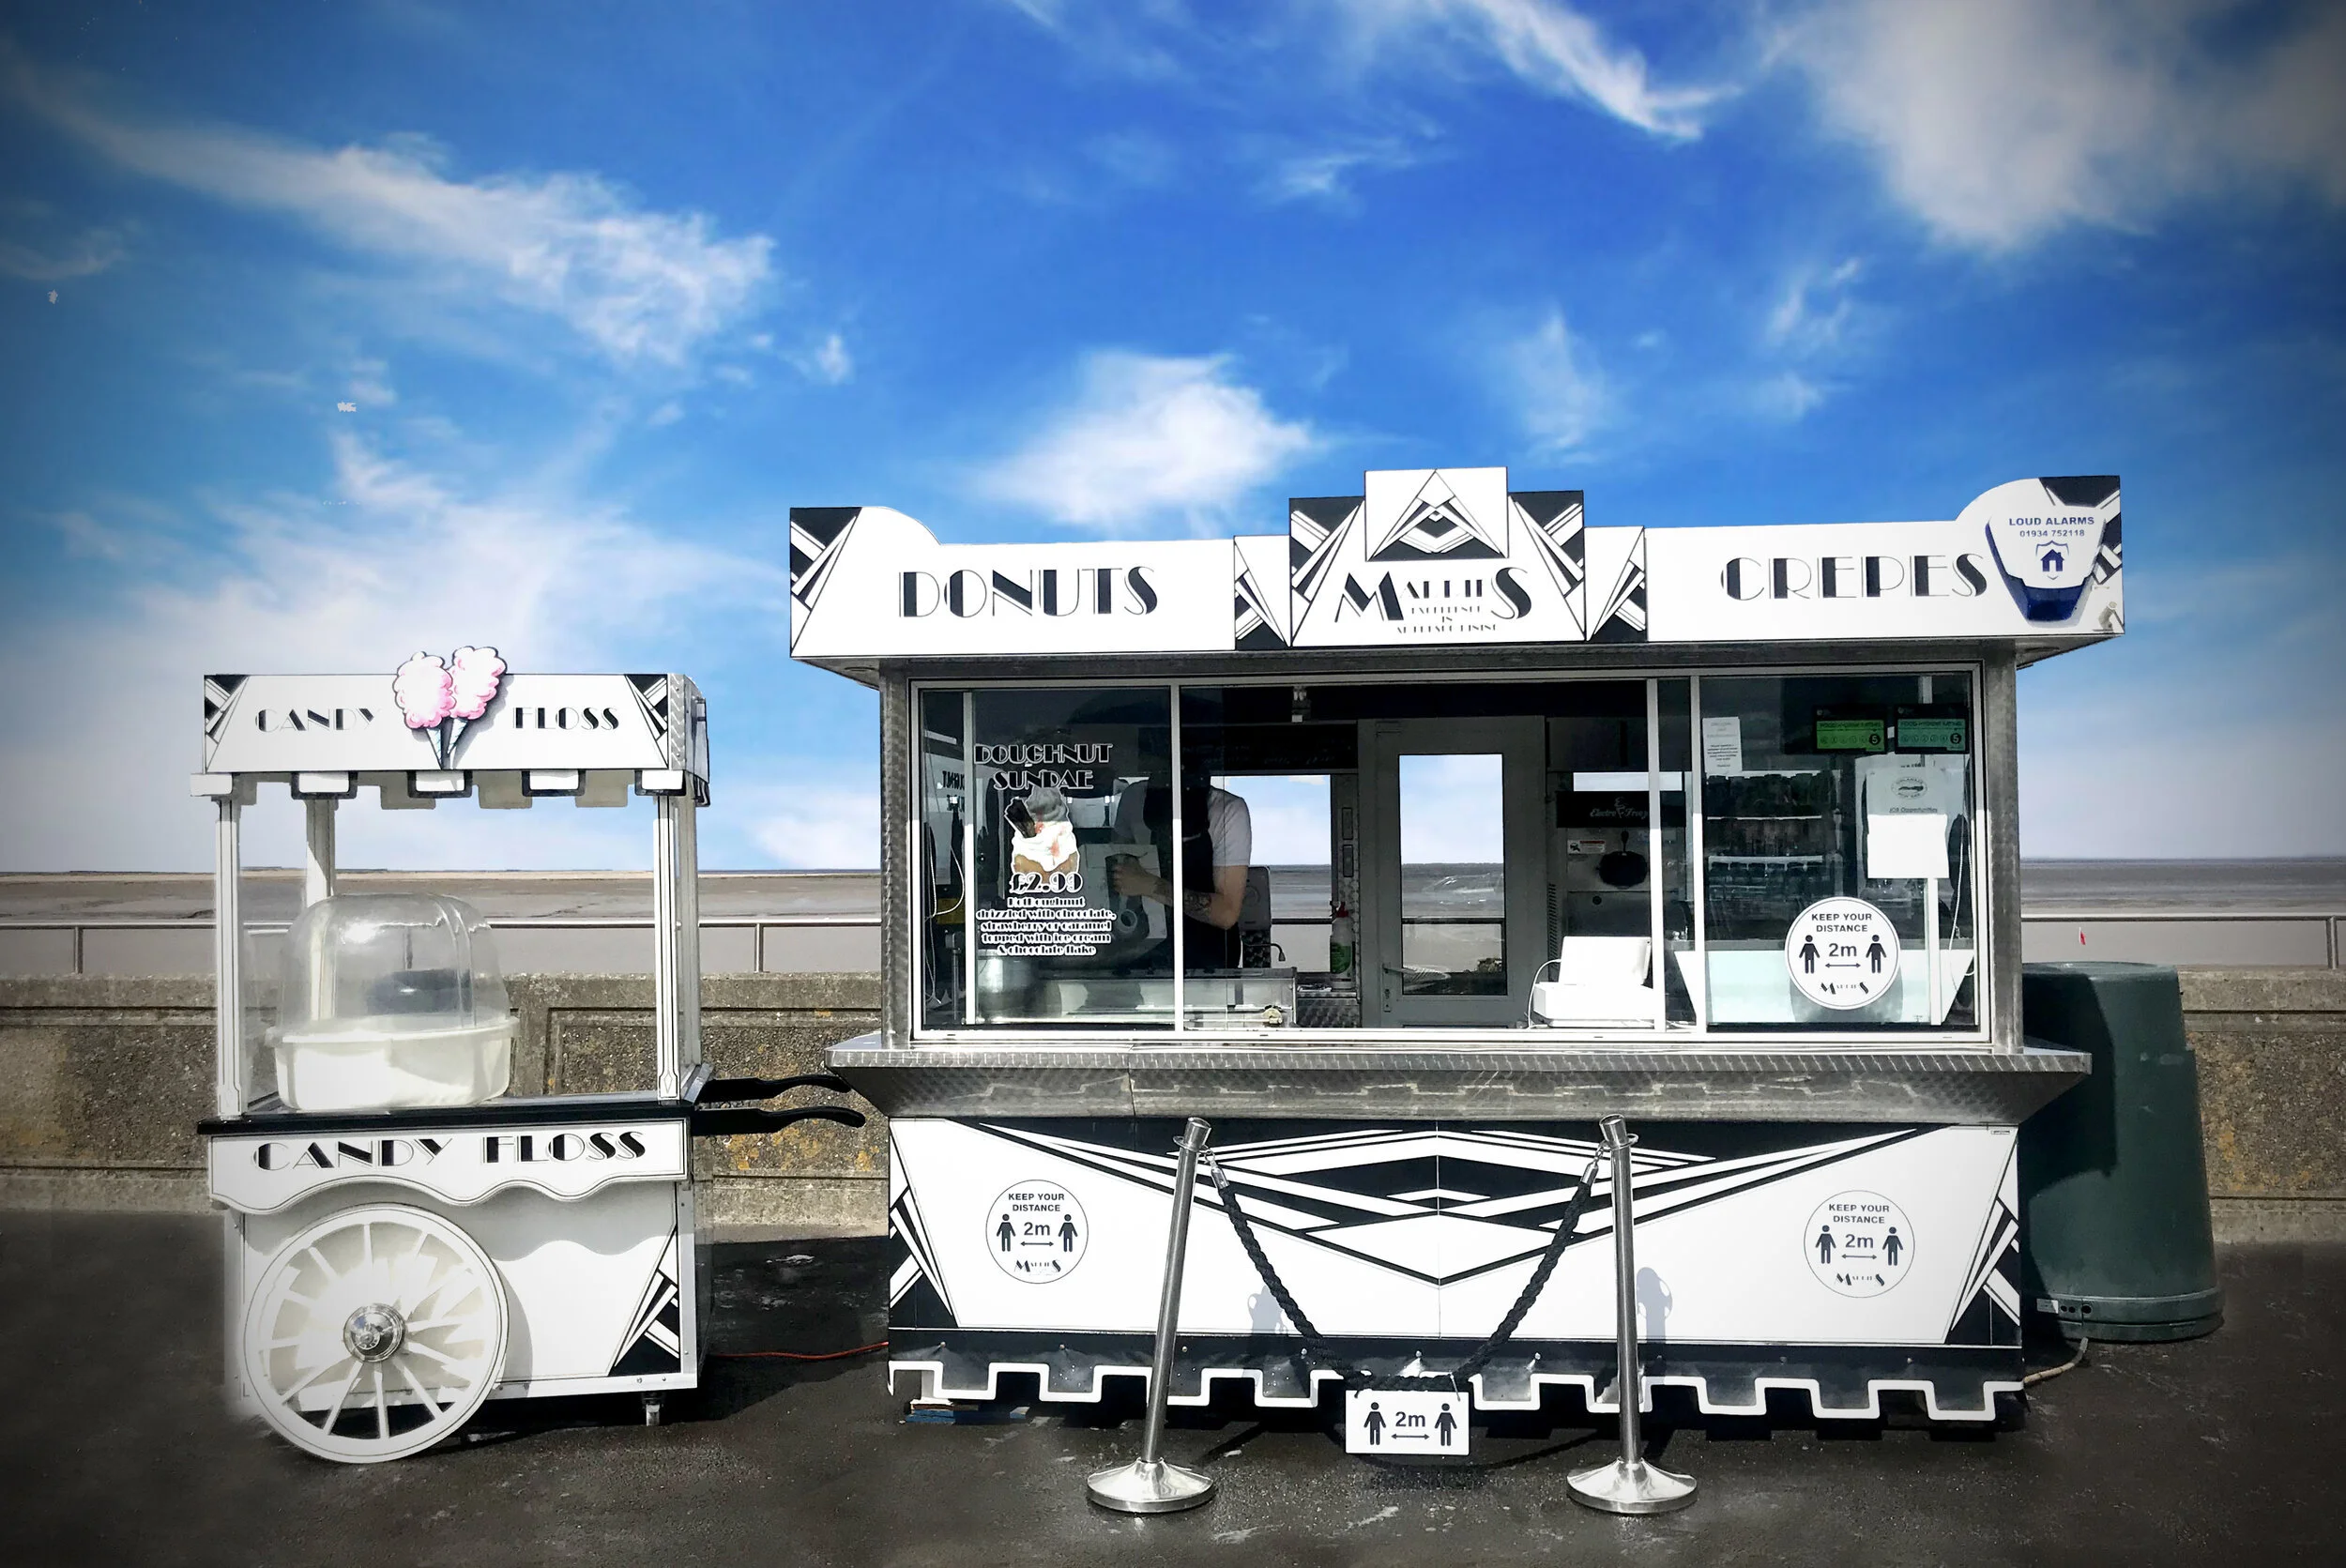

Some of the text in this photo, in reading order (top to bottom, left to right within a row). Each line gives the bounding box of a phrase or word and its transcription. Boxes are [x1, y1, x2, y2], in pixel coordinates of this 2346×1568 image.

[2008, 516, 2095, 526] LOUD ALARMS
[2019, 529, 2049, 538] 01934
[1719, 552, 1988, 601] CREPES
[898, 566, 1158, 618] DONUTS
[254, 706, 620, 734] CANDY FLOSS
[1870, 735, 1879, 744] 5
[1952, 734, 1960, 743] 5
[973, 743, 1114, 765] DOUGHNUT
[993, 769, 1094, 790] SUNDAE
[1008, 871, 1084, 894] £2.99
[1028, 908, 1055, 921] with
[1811, 913, 1873, 921] KEEP YOUR
[1816, 924, 1868, 933] DISTANCE
[1024, 933, 1053, 944] with
[1052, 933, 1072, 944] ice
[1007, 945, 1064, 956] chocolate
[1064, 944, 1097, 956] flake
[1828, 942, 1858, 958] 2m
[251, 1131, 647, 1172] CANDY FLOSS
[1008, 1193, 1065, 1201] KEEP YOUR
[1012, 1204, 1061, 1212] DISTANCE
[1828, 1203, 1890, 1212] KEEP YOUR
[1833, 1214, 1885, 1224] DISTANCE
[1023, 1221, 1051, 1236] 2m
[1844, 1233, 1874, 1249] 2m
[1394, 1410, 1426, 1428] 2m
